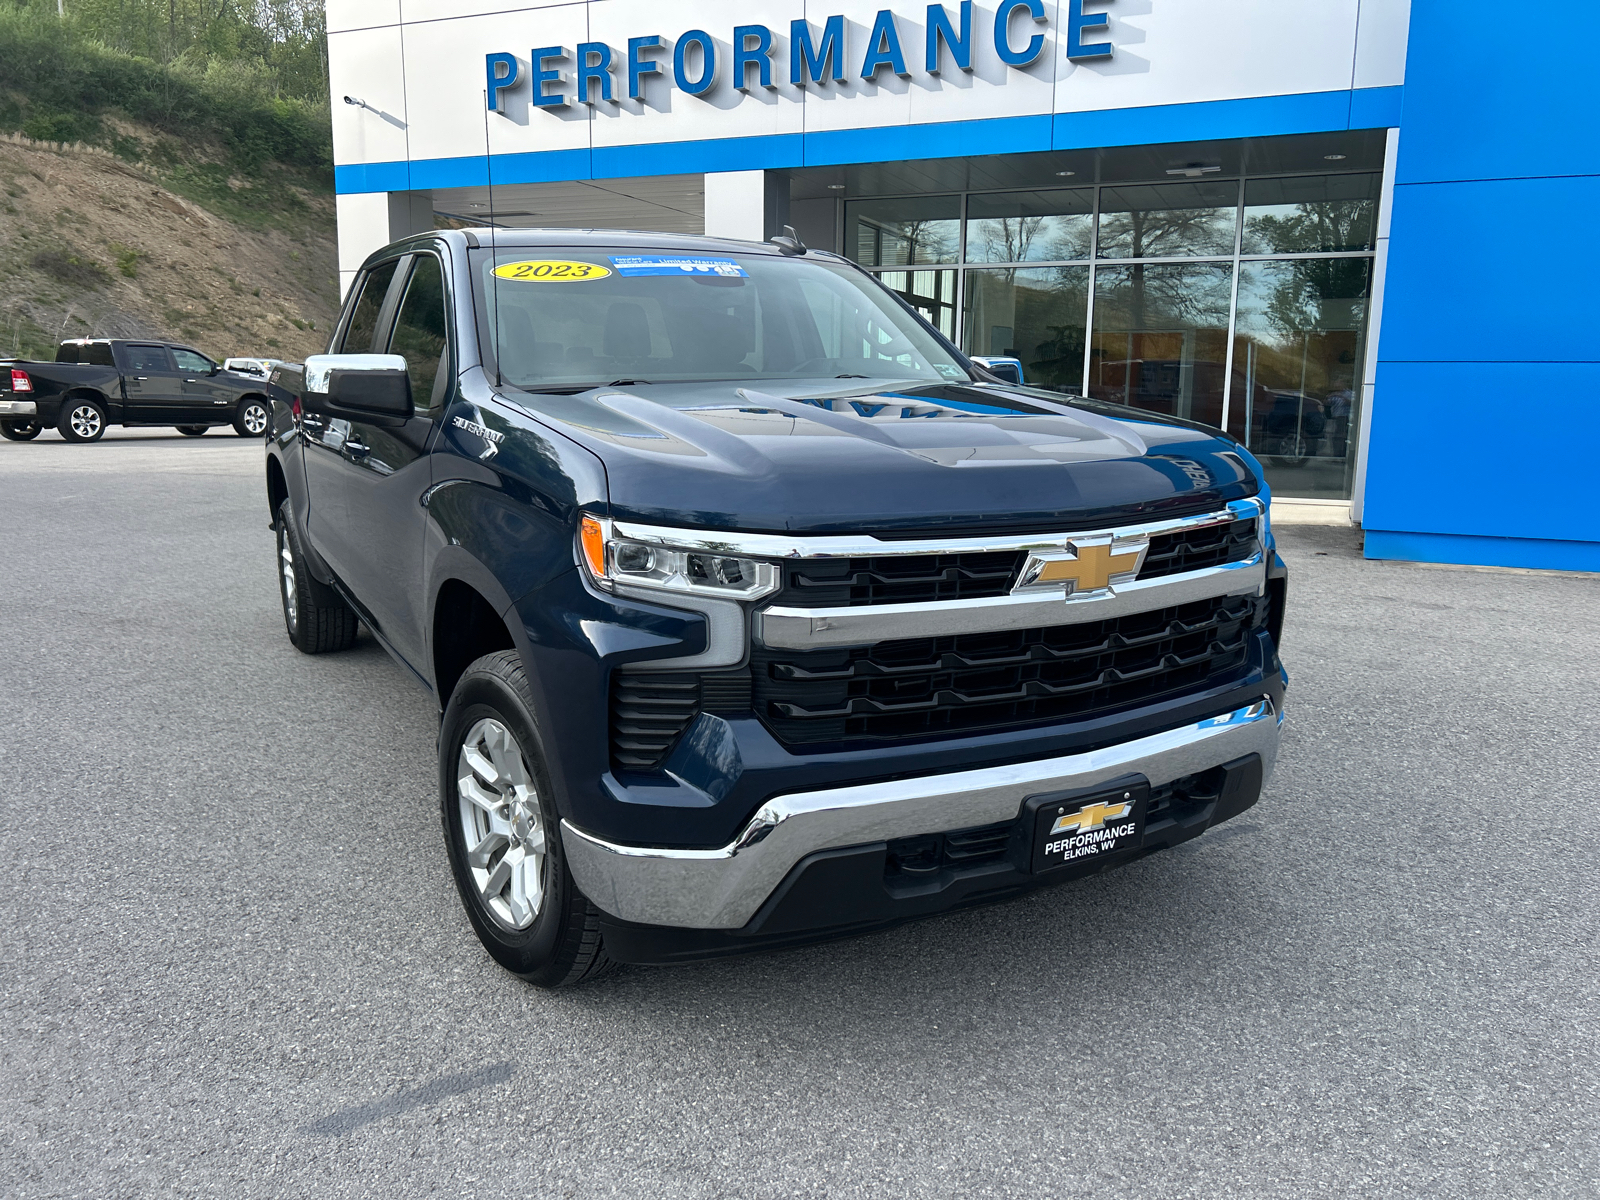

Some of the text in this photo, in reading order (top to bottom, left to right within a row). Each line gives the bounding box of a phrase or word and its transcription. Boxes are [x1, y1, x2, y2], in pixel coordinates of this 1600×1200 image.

[486, 0, 1114, 113] PERFORMANCE
[512, 264, 592, 278] 2023
[692, 259, 732, 267] Warranty
[1045, 823, 1135, 854] PERFORMANCE
[1064, 839, 1116, 860] ELKINS, WV
